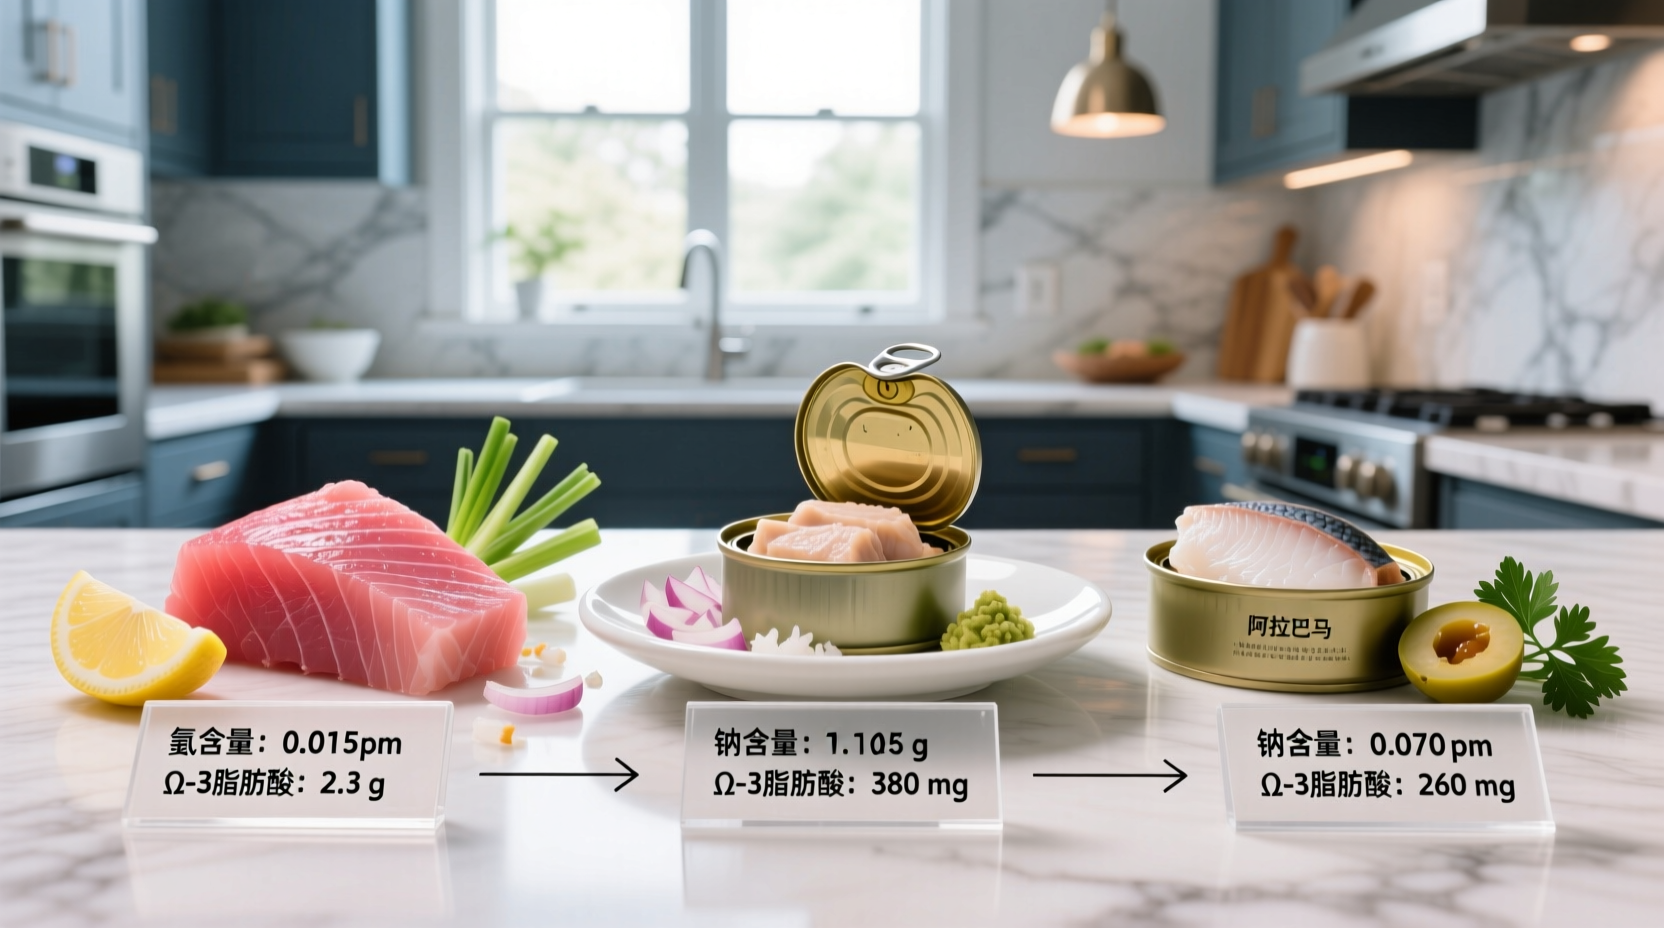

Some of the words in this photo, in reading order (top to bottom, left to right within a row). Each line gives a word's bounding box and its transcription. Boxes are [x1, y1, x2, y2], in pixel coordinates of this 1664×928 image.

[1247, 614, 1332, 640] 阿拉巴马
[911, 737, 928, 763] g
[368, 777, 385, 802] g
[928, 777, 968, 803] mg
[1474, 779, 1516, 804] mg
